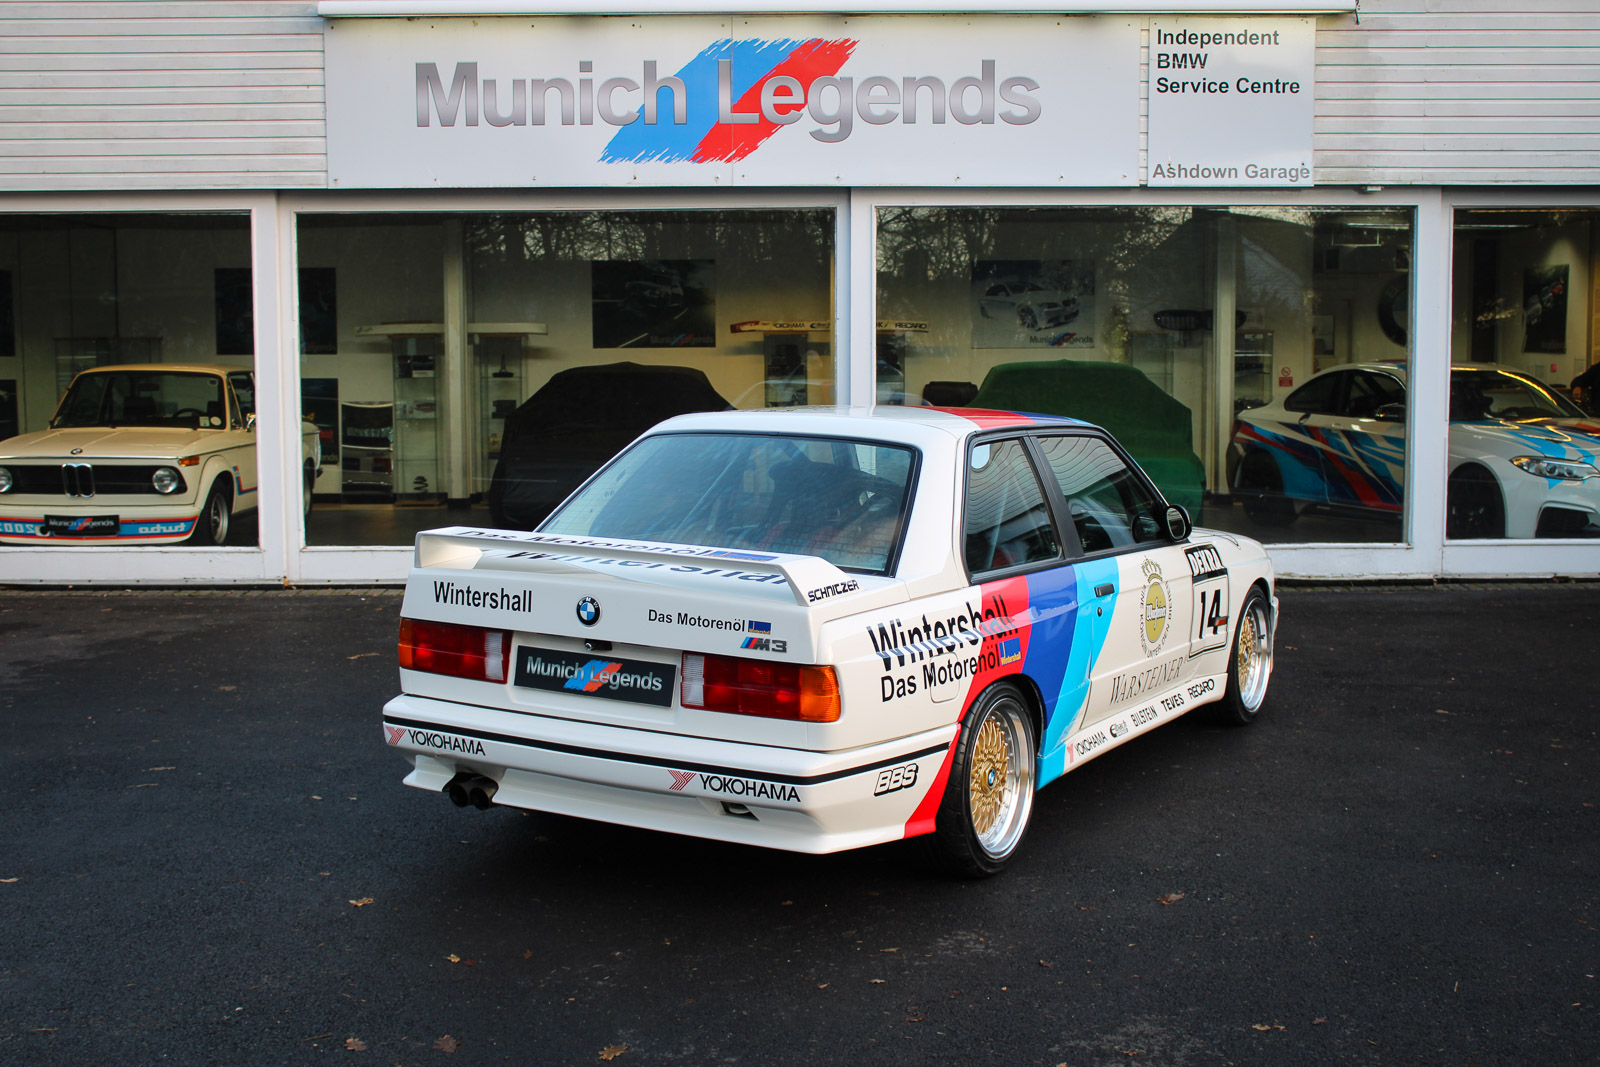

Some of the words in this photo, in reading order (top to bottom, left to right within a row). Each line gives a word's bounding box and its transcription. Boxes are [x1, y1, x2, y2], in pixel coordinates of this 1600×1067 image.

[1157, 29, 1280, 48] Independent
[1157, 53, 1208, 69] BMW
[1156, 77, 1229, 94] Service
[1236, 77, 1300, 94] Centre
[415, 60, 687, 127] Munich
[717, 58, 1042, 143] Legends
[1152, 163, 1238, 179] Ashdown
[1244, 163, 1310, 182] Garage
[49, 518, 76, 527] Munich
[1188, 549, 1225, 577] DEKRA
[433, 580, 533, 623] Wintershall
[807, 579, 860, 603] SCHNITZER
[648, 608, 673, 624] Das
[677, 612, 746, 632] Motorenöl
[1199, 589, 1221, 639] 14
[752, 636, 787, 653] M3
[866, 594, 1019, 672] Wintershall
[526, 655, 584, 681] Munich
[590, 665, 663, 691] Legends
[880, 674, 917, 702] Das
[922, 643, 1000, 690] Motorenöl
[1109, 656, 1184, 705] WARSTEINER
[1074, 730, 1108, 757] YOKOHAMA
[1130, 704, 1159, 727] BILSTEIN
[1160, 693, 1185, 712] TEVES
[1187, 678, 1215, 699] RECARO
[408, 729, 486, 756] YOKOHAMA
[700, 773, 801, 803] YOKOHAMA
[873, 763, 918, 796] BBS
